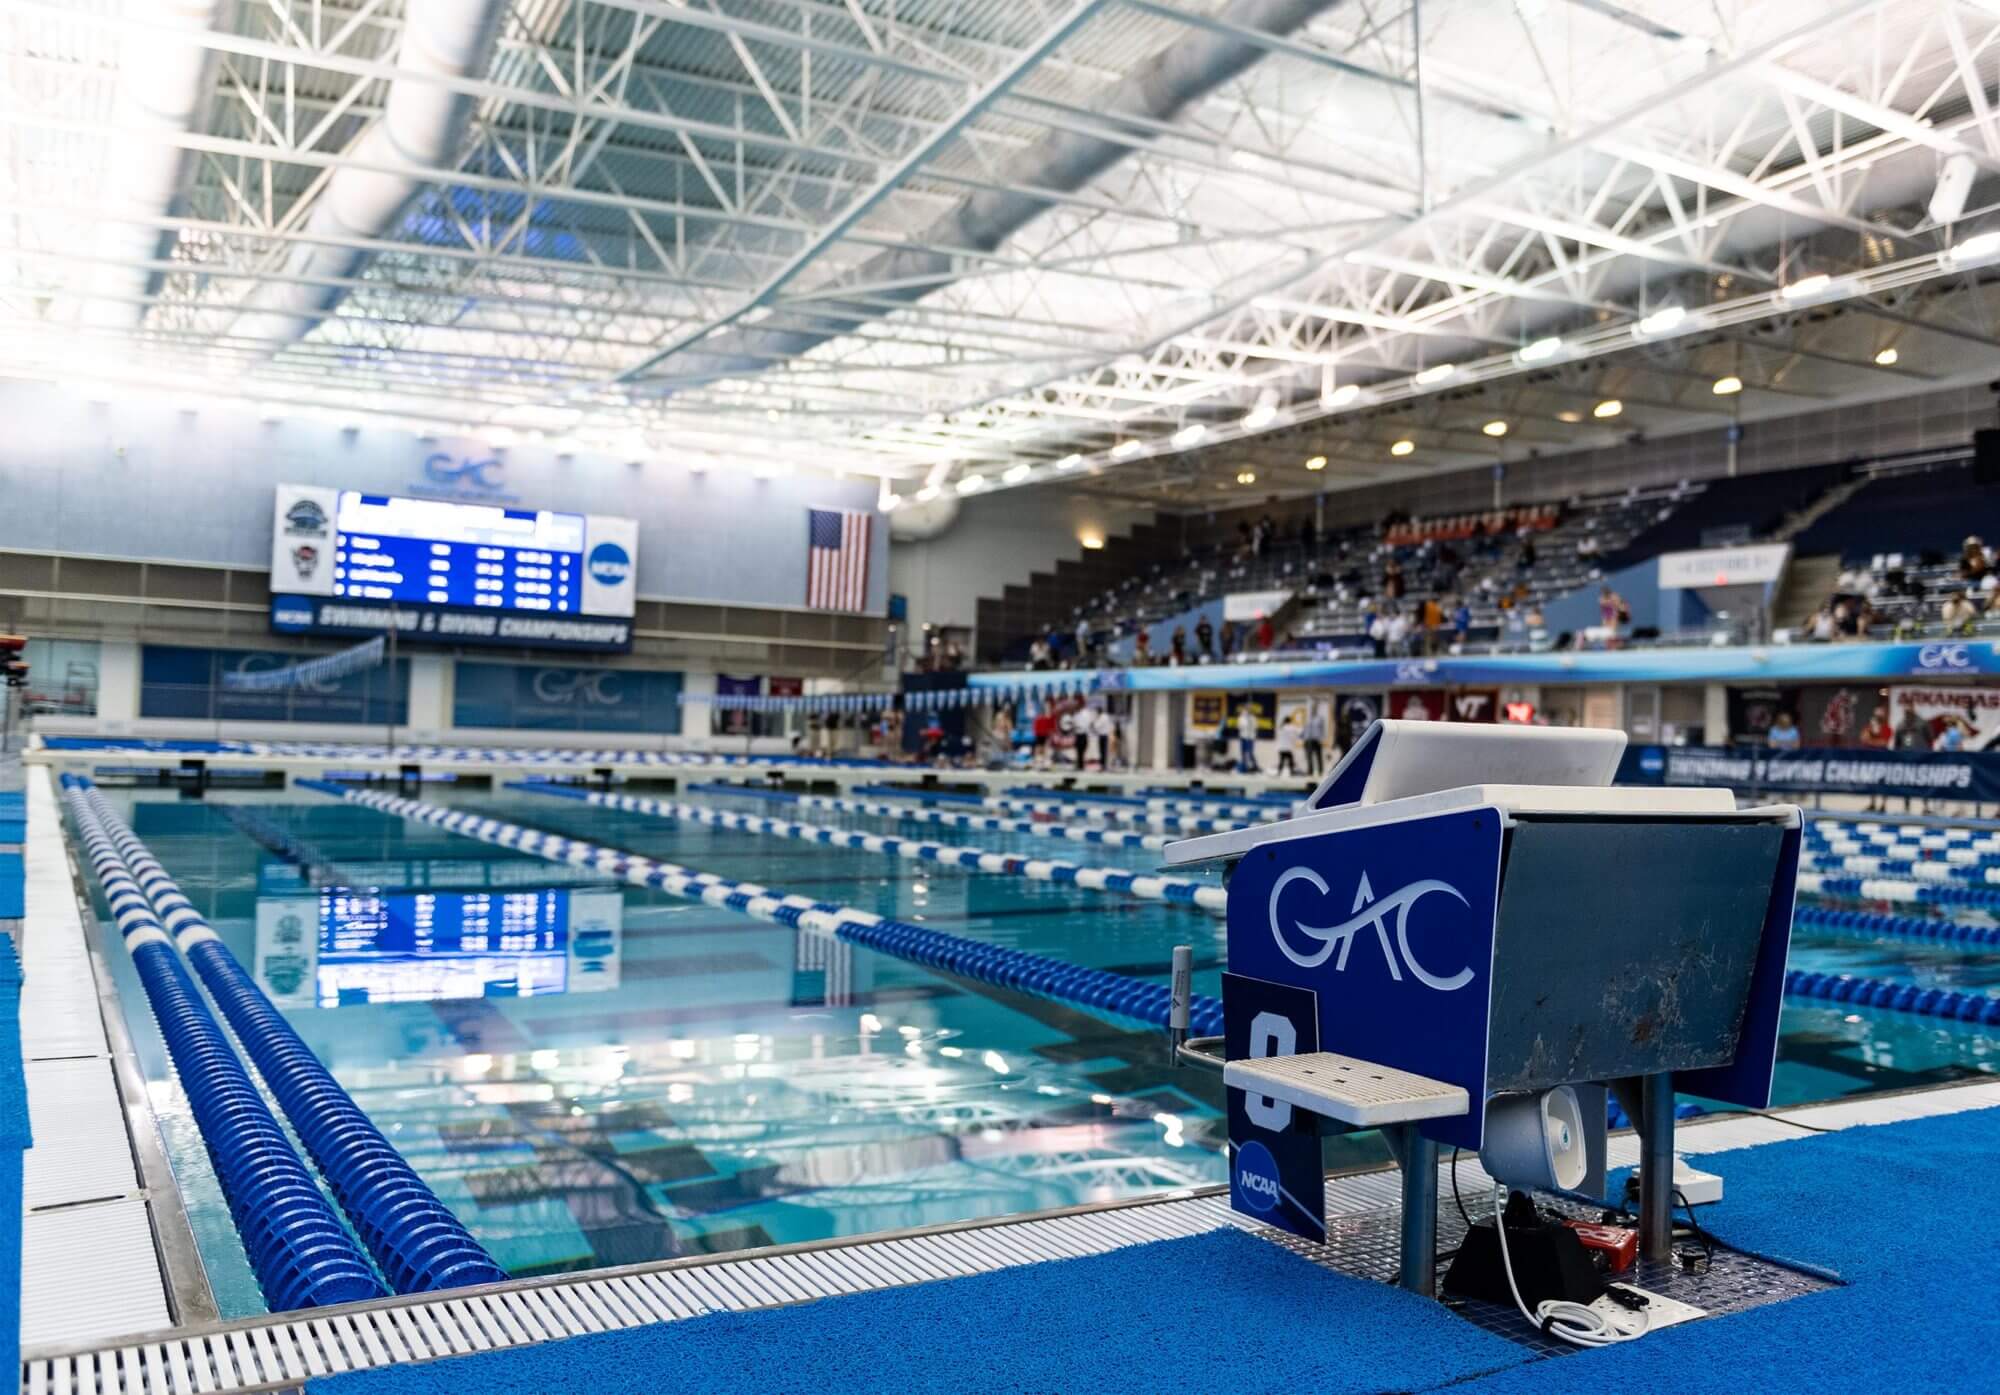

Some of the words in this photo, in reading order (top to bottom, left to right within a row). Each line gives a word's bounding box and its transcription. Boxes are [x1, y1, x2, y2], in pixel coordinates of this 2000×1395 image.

[319, 604, 419, 631] SWIMMING
[422, 611, 436, 632] &
[438, 613, 498, 636] DIVING
[499, 616, 628, 645] CHAMPIONSHIPS
[1918, 643, 1970, 668] GAC
[533, 669, 625, 704] GAC
[1455, 694, 1488, 719] VT
[1826, 760, 1972, 788] CHAMPIONSHIPS
[1268, 865, 1476, 991] GAC
[1241, 1169, 1280, 1199] NCAA
